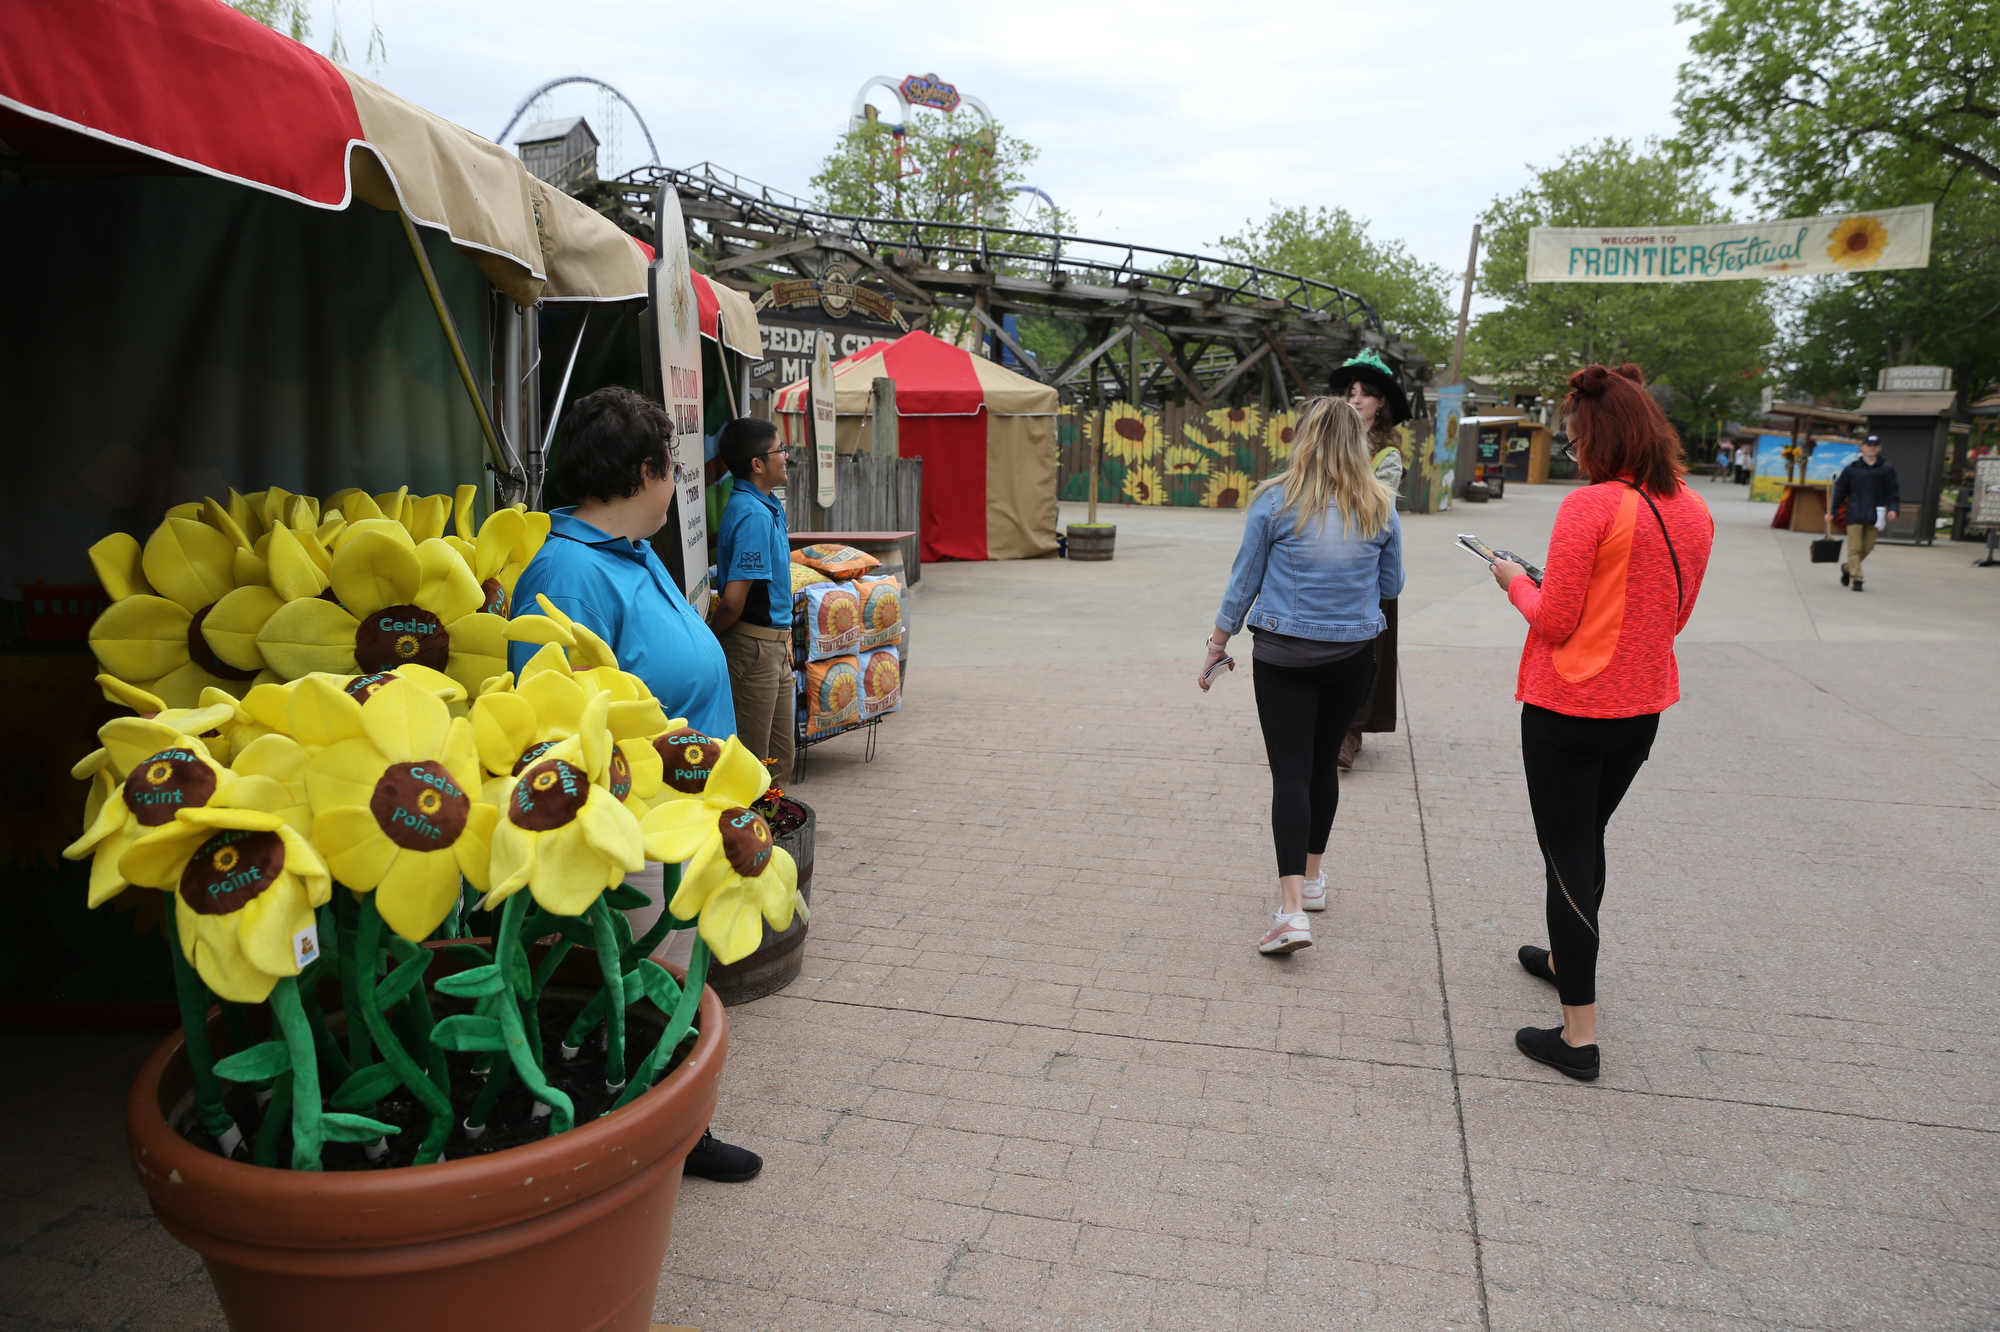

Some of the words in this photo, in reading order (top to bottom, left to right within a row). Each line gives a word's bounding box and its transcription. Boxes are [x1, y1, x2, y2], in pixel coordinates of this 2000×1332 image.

[1600, 236, 1656, 245] WELCOME
[1660, 235, 1676, 244] TO
[1568, 246, 1707, 277] FRONTIER
[1703, 226, 1809, 277] Festival
[822, 283, 837, 295] EDAR
[753, 361, 775, 378] CEDAR
[1889, 368, 1941, 377] WOODEN
[379, 617, 437, 635] Cedar
[410, 766, 463, 800] Cedar
[133, 786, 184, 806] Point
[391, 807, 442, 840] Point
[207, 865, 262, 900] Point
